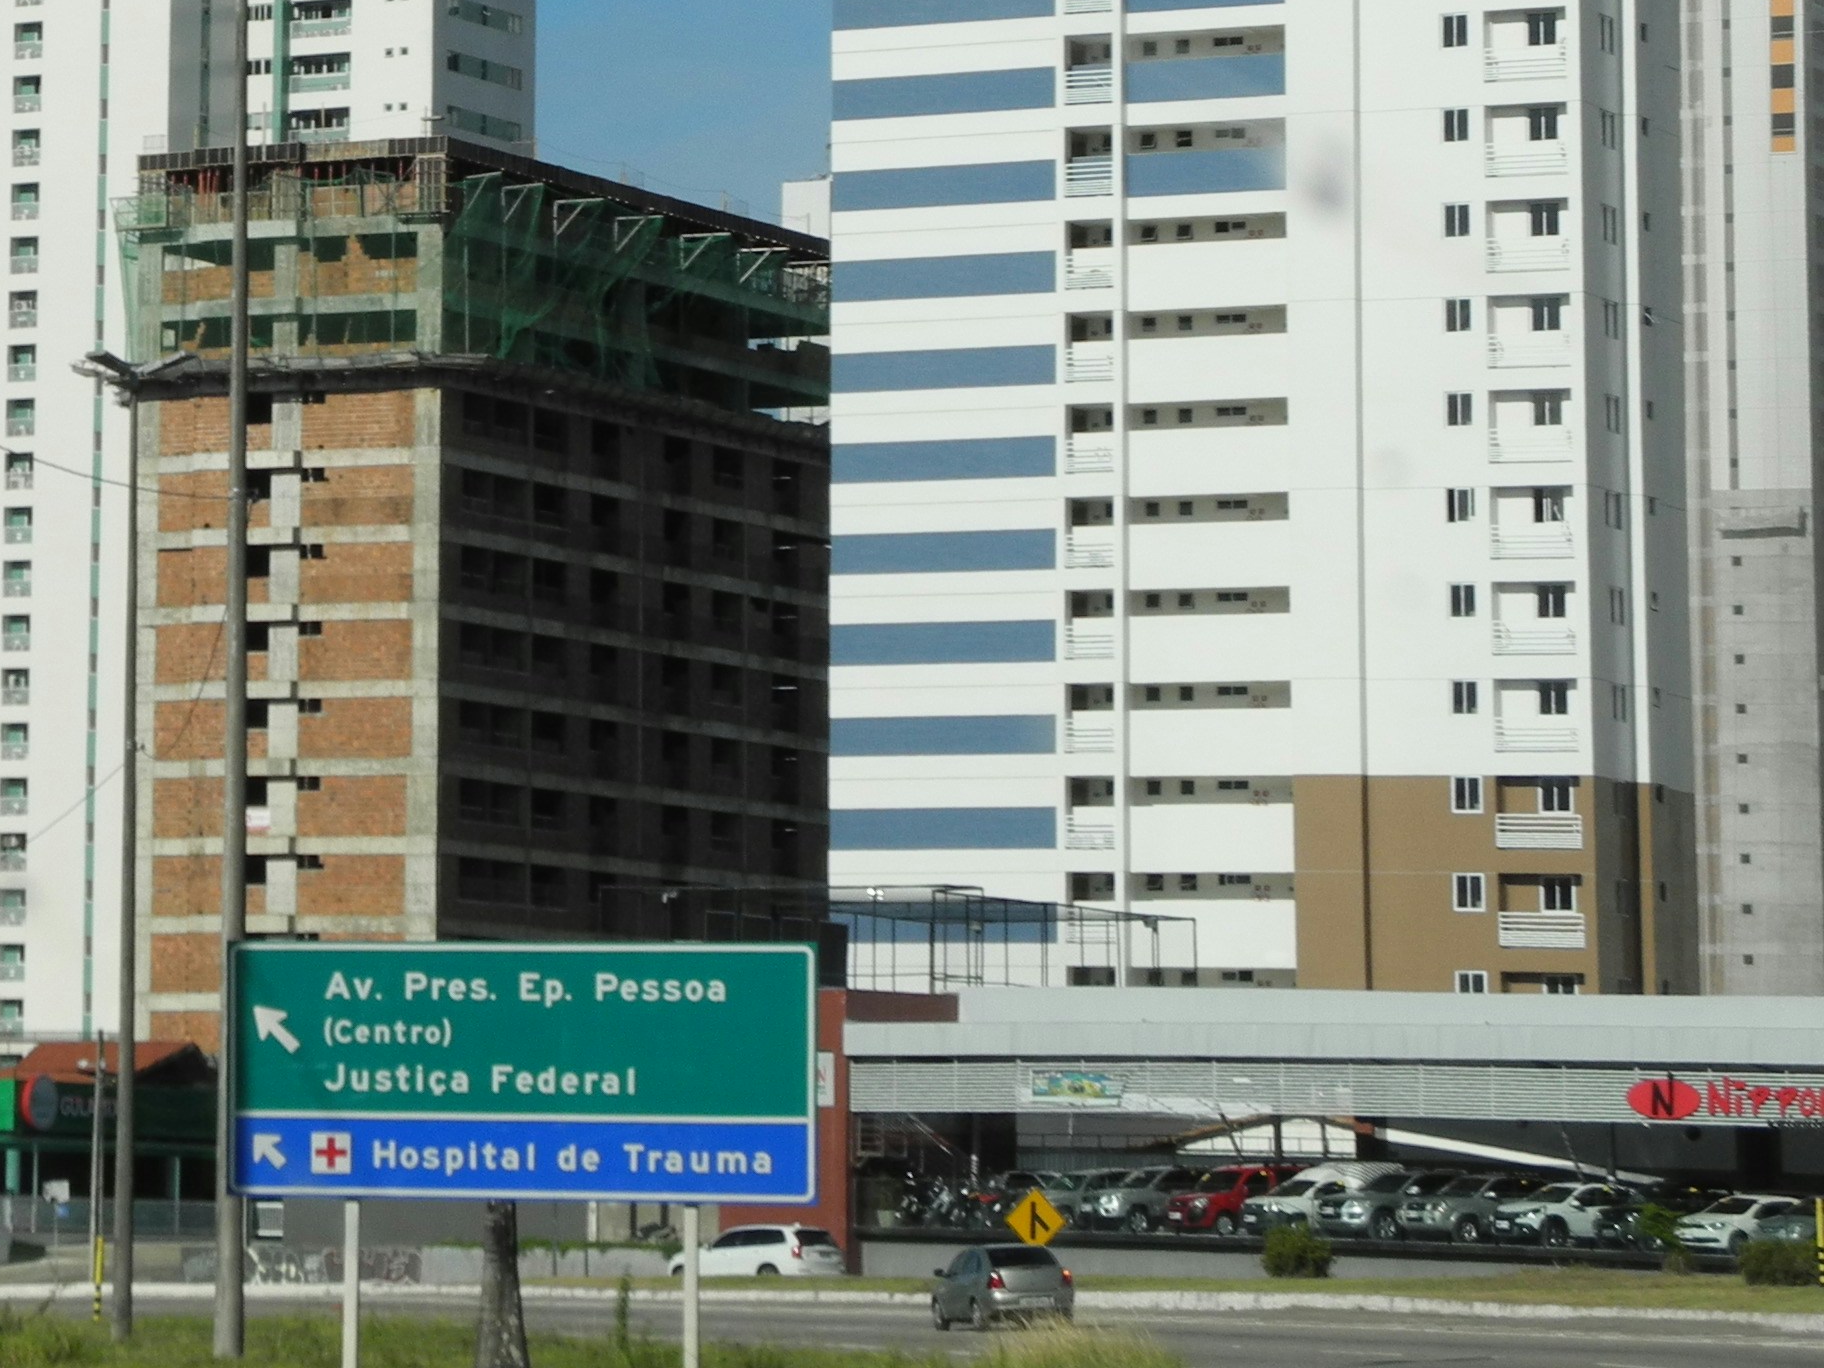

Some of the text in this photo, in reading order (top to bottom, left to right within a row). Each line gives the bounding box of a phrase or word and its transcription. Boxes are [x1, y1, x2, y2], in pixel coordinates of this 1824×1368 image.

[325, 971, 727, 1008] Av. Pres. Ep. Pessoa
[324, 1017, 452, 1048] (Centro)
[324, 1063, 636, 1096] Justiça Federal
[373, 1139, 773, 1177] Hospital de Trauma
